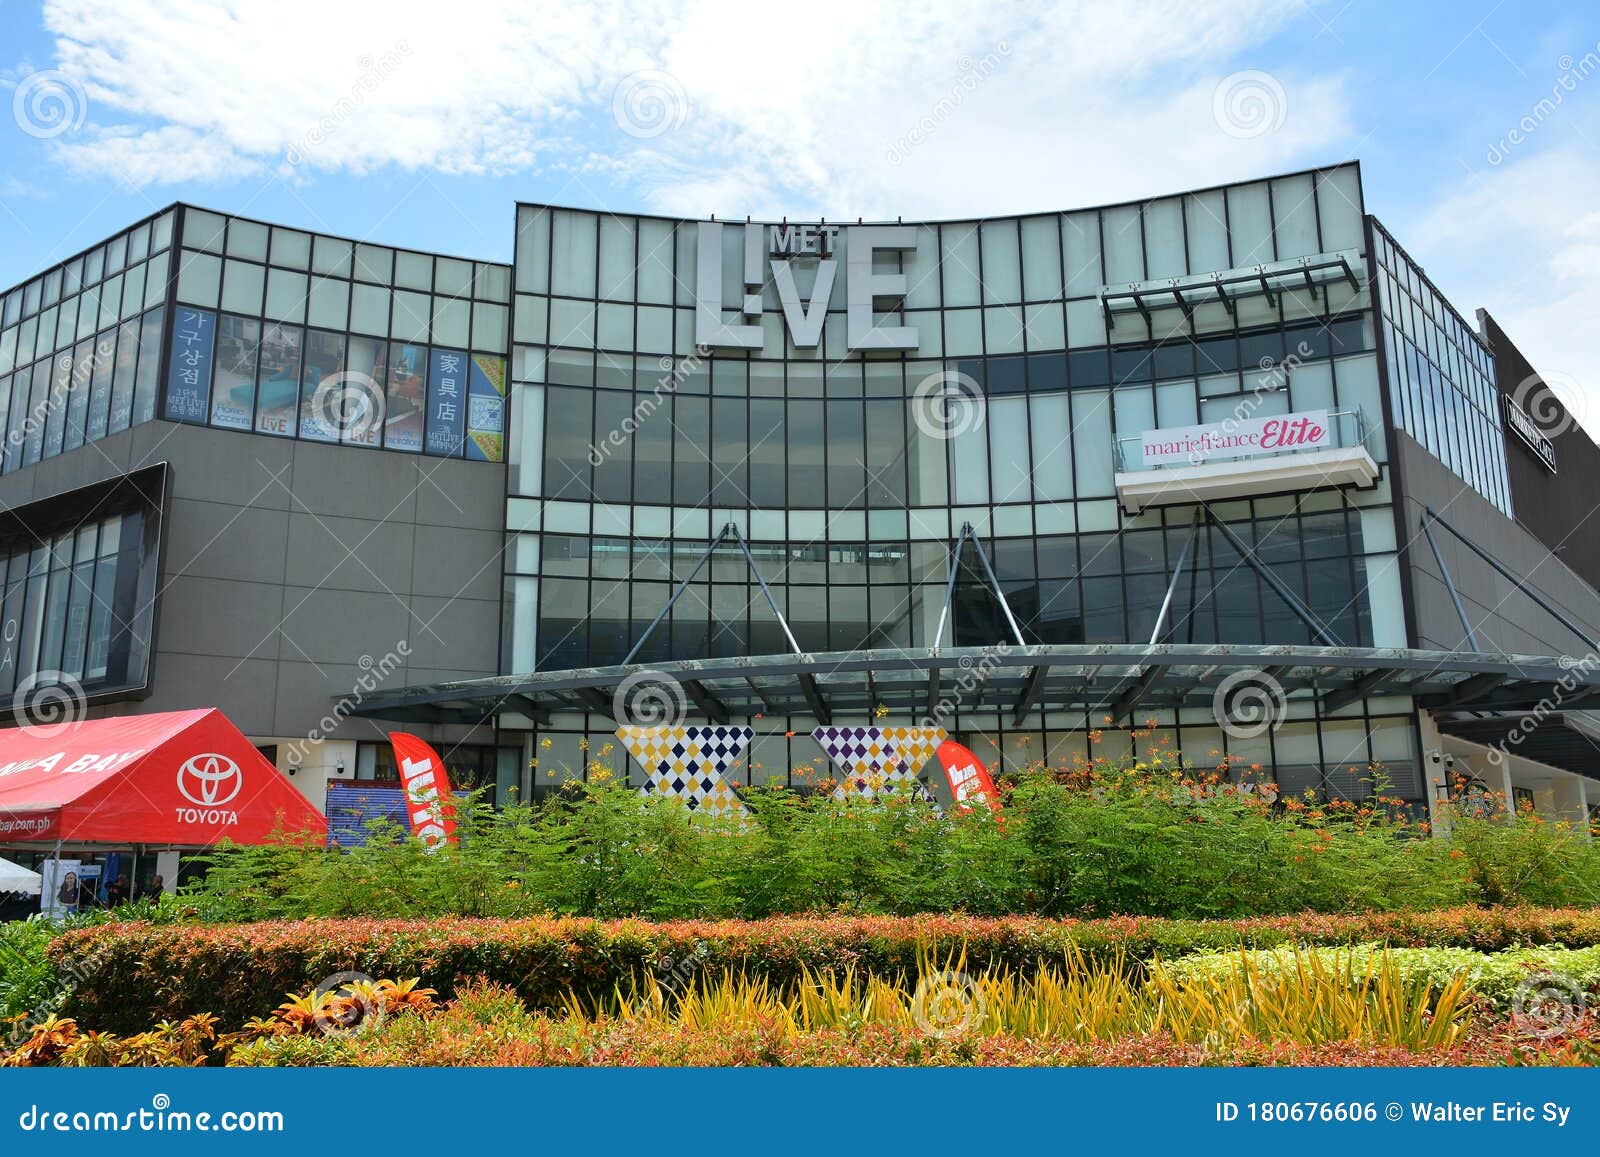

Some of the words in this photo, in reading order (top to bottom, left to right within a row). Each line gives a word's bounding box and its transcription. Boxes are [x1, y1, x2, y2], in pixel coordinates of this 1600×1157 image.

[769, 225, 840, 256] MET
[177, 311, 208, 386] 가구상점
[436, 354, 460, 422] 家具店
[1144, 432, 1260, 457] mariefrance
[1260, 416, 1327, 450] Elite
[61, 749, 146, 774] BAY
[175, 807, 239, 825] TOYOTA
